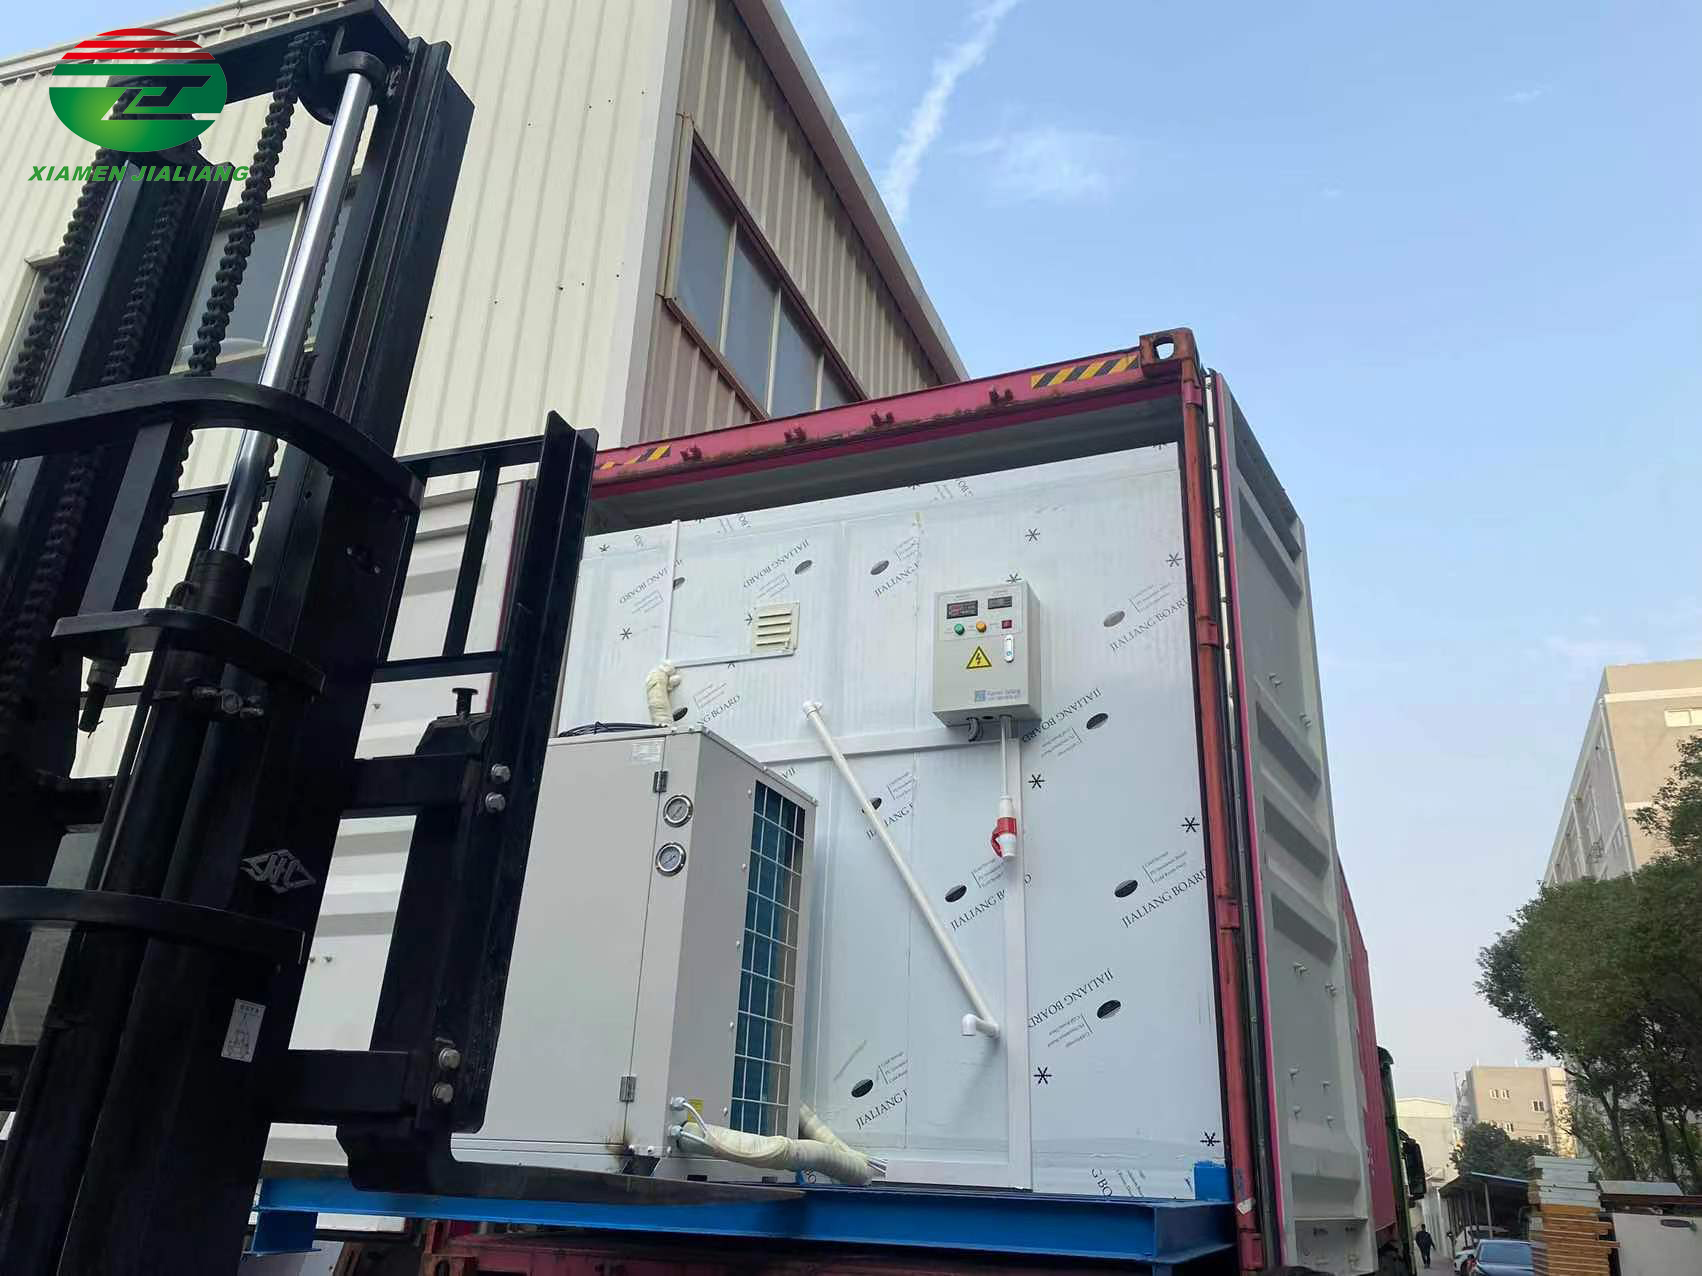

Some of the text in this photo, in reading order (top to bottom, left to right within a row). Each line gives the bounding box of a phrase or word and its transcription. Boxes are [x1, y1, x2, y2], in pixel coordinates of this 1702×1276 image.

[1109, 617, 1157, 655] JIALIANG
[1055, 688, 1102, 721] JIALIANG
[1022, 717, 1057, 743] BOARD
[950, 895, 997, 932] JIALIANG
[1122, 891, 1172, 928] JIALIANG
[1063, 968, 1114, 1006] JIALIANG
[856, 1093, 903, 1130] JIALIANG
